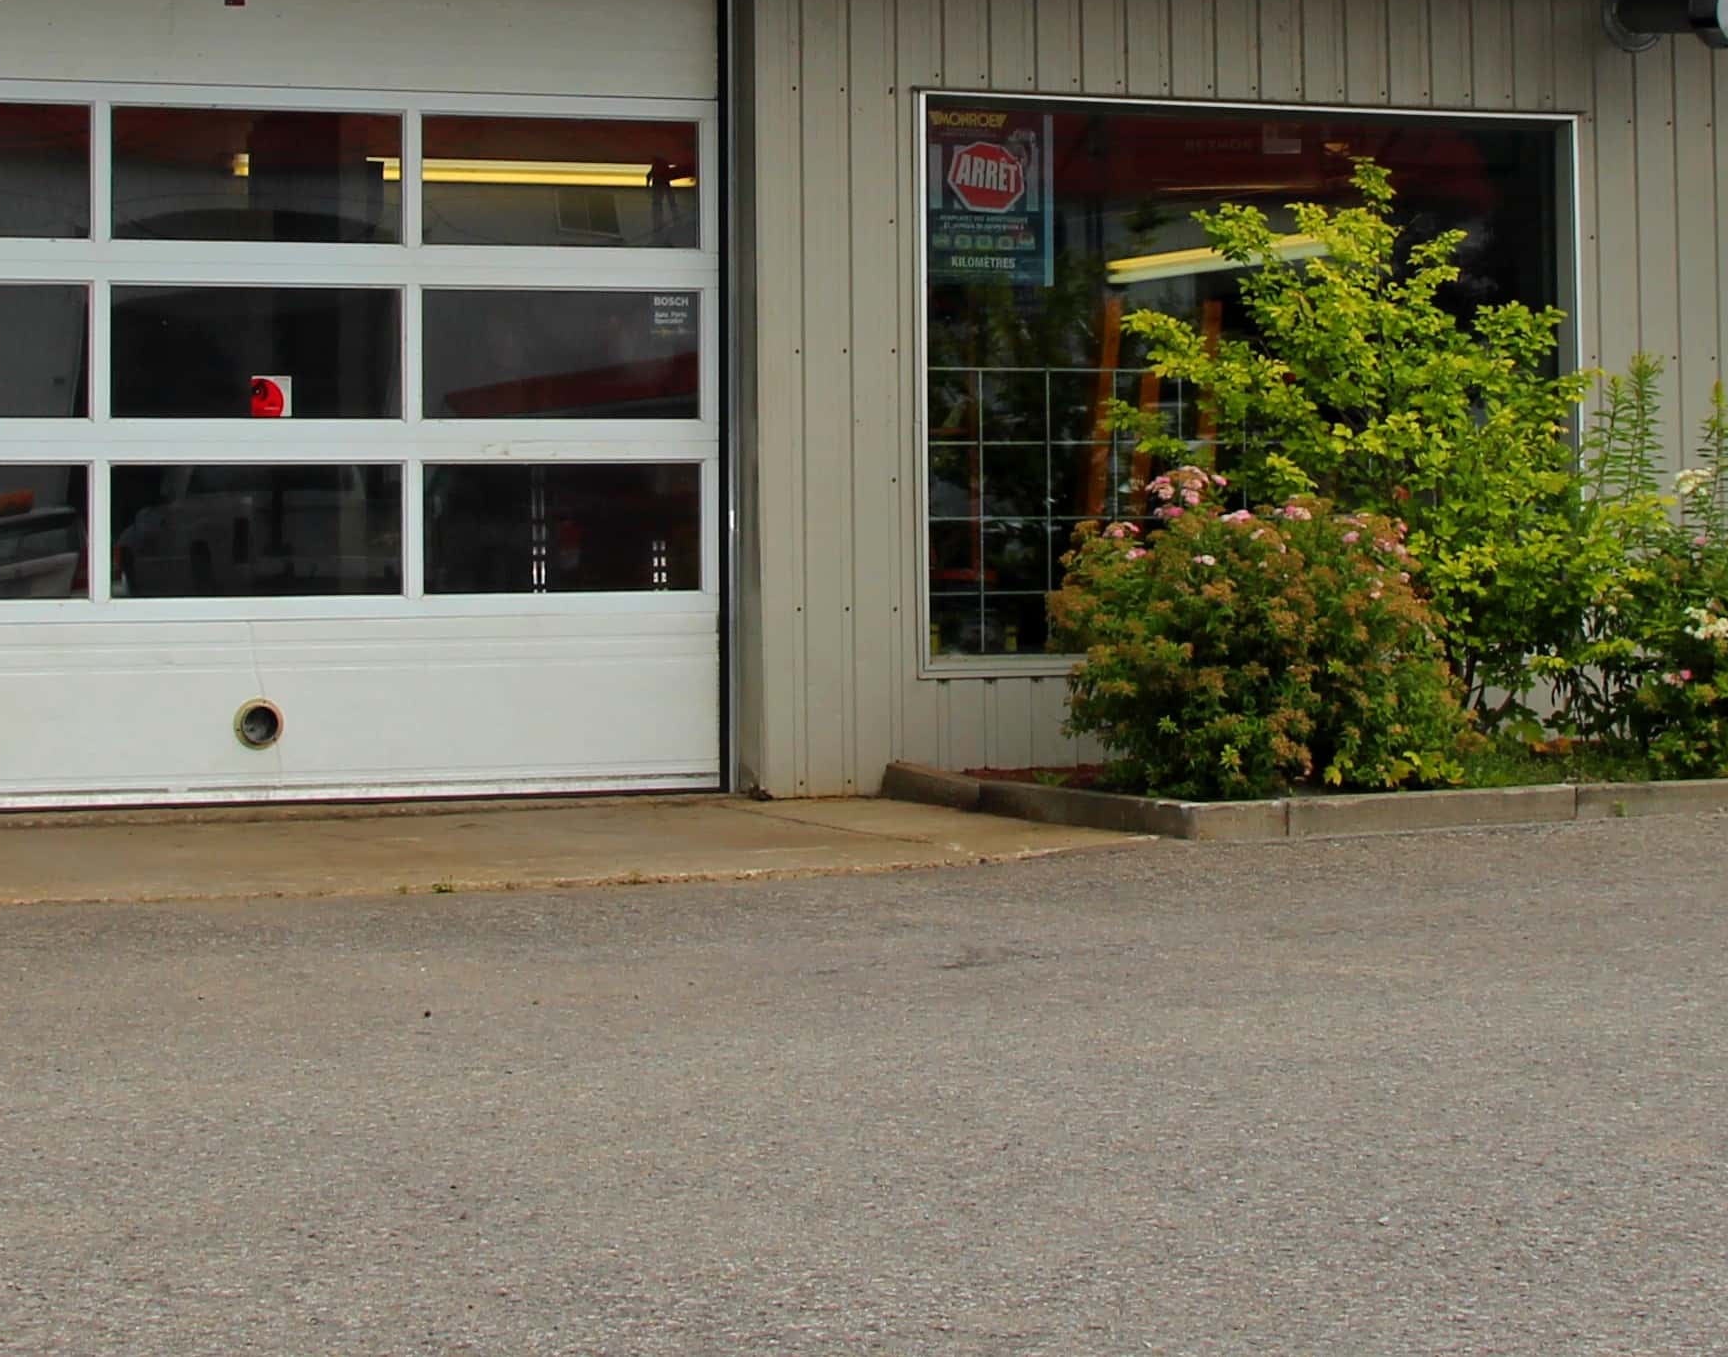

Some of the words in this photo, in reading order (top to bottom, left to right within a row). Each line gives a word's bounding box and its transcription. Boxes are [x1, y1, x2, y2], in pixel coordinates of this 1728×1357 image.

[955, 154, 1017, 193] ARRÊT
[951, 254, 1016, 269] KILOMÈTRES
[654, 296, 689, 307] BOSCH
